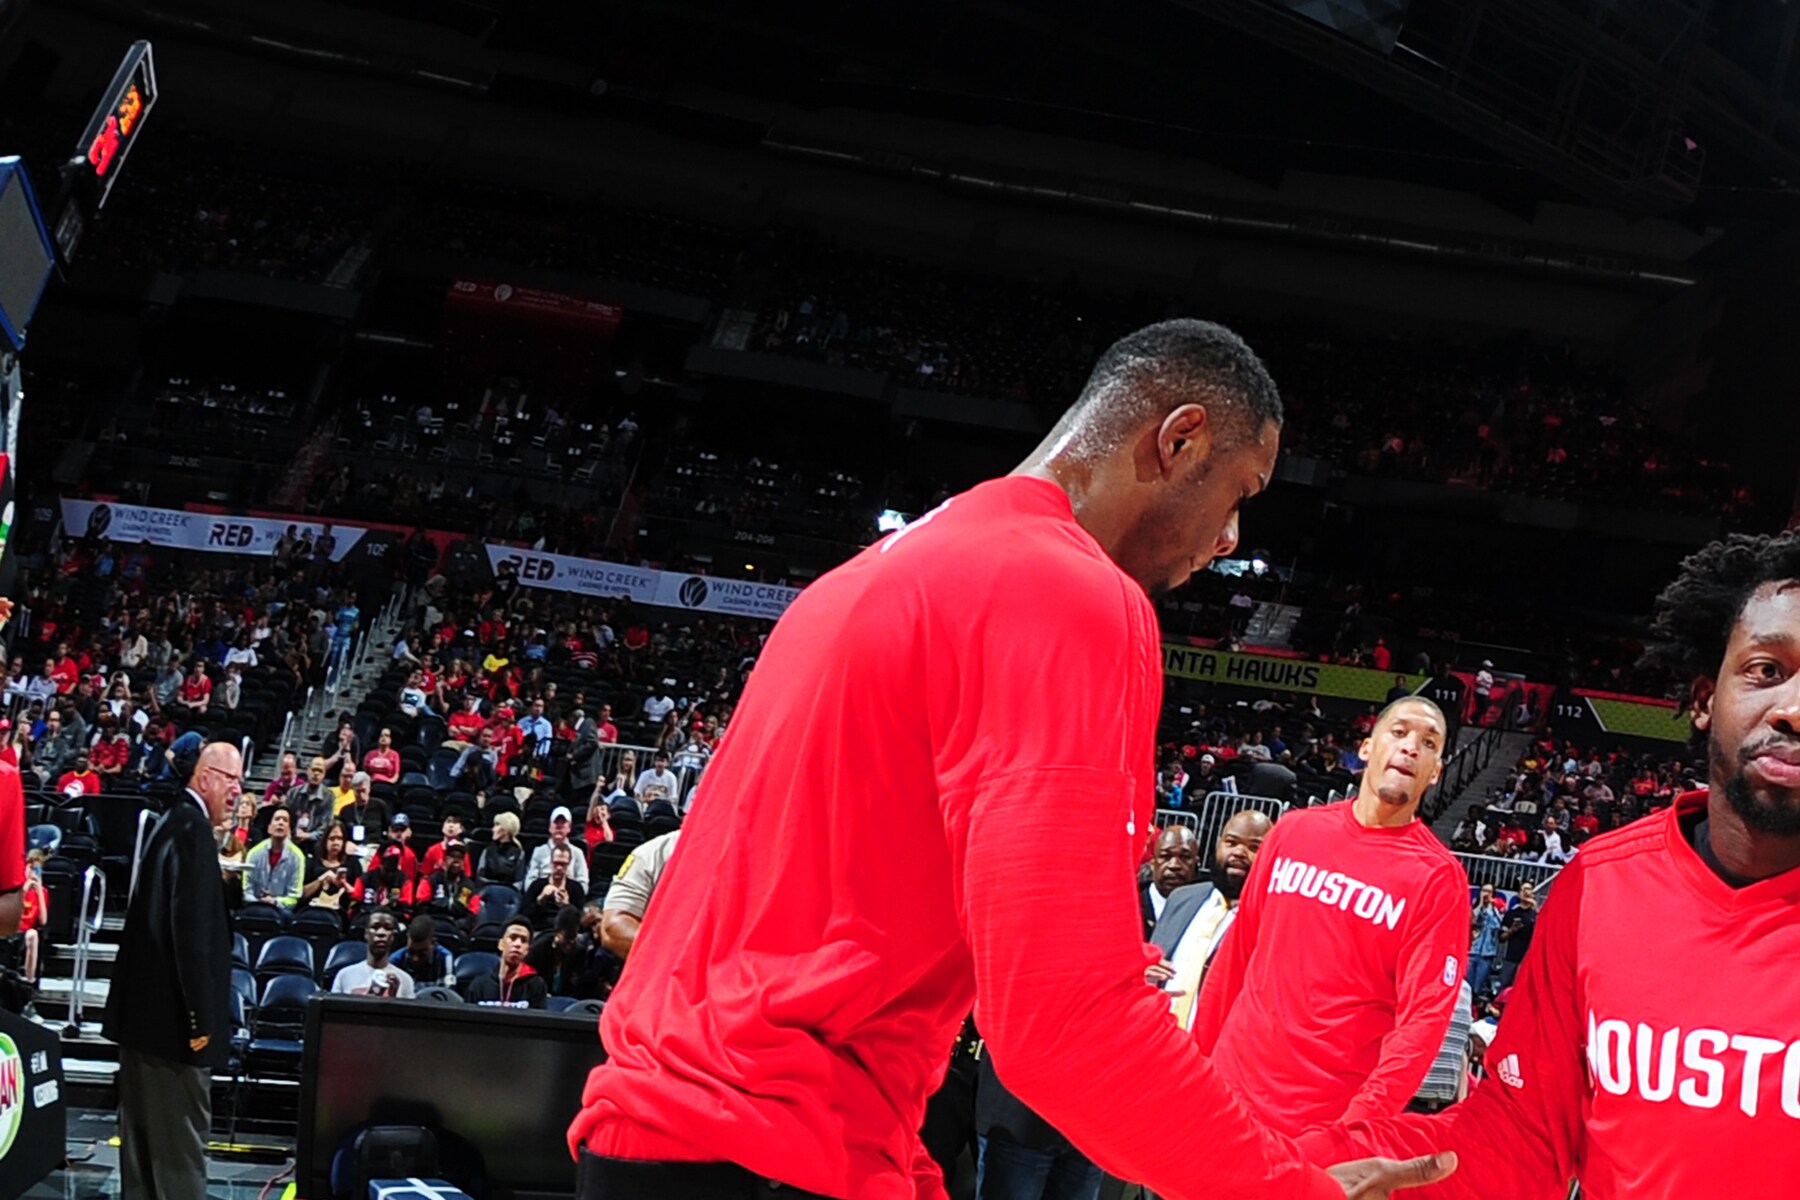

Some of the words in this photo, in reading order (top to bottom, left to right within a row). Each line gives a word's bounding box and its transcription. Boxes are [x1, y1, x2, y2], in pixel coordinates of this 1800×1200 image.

[115, 505, 147, 522] WIND
[150, 511, 188, 527] CREEK
[209, 524, 254, 547] RED
[508, 554, 554, 581] RED
[568, 566, 604, 581] WIND
[606, 572, 648, 588] CREEK
[712, 581, 753, 597] WIND
[756, 587, 798, 603] CREE
[1164, 650, 1217, 675] NTA
[1226, 656, 1320, 688] HAWKS
[1434, 688, 1457, 702] 111
[1557, 704, 1583, 719] 112
[1267, 856, 1406, 932] HOUSTON
